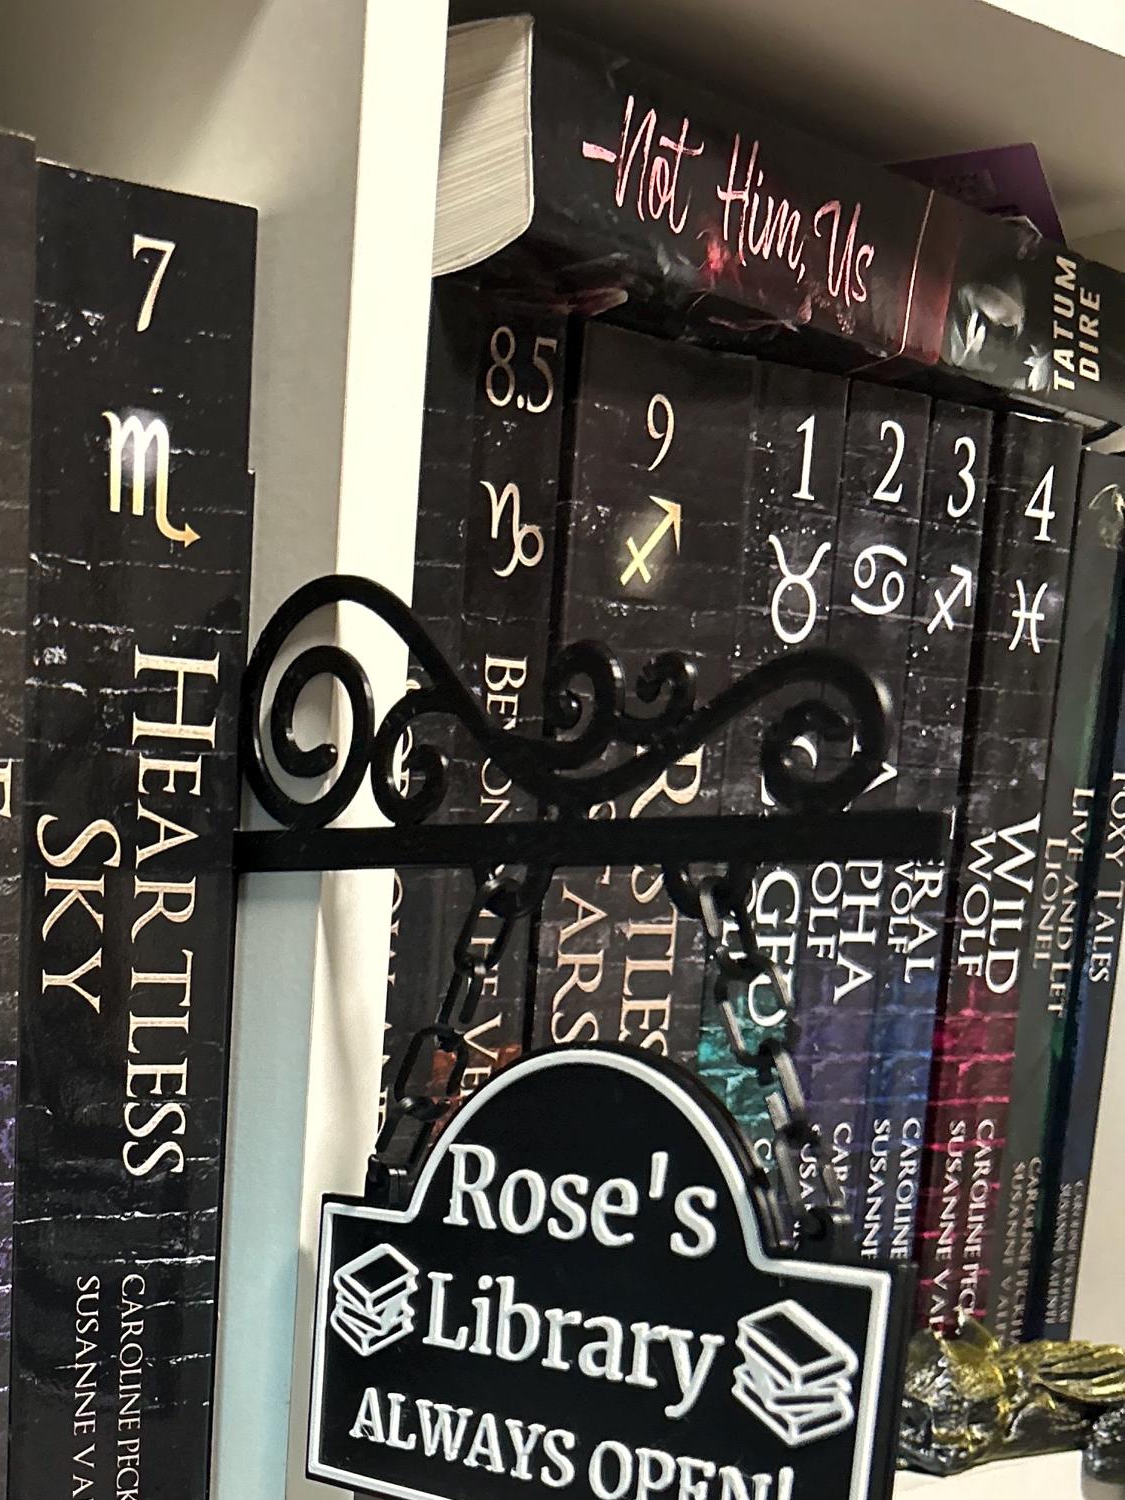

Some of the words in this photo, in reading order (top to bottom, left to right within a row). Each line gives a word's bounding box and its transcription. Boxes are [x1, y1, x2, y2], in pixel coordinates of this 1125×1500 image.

[716, 133, 807, 283] Him,
[813, 199, 875, 306] Us
[132, 235, 175, 332] 7
[1053, 256, 1076, 390] TATUM
[1079, 287, 1100, 382] DIRE
[485, 326, 558, 413] 8.5
[647, 394, 674, 471] 9
[792, 415, 816, 501] 1
[878, 420, 906, 503] 2
[948, 437, 977, 518] 3
[1025, 466, 1055, 542] 4
[1068, 787, 1095, 861] LIVE
[36, 814, 123, 1014] SKY
[122, 644, 220, 1178] HEARTLESS
[807, 862, 842, 959] OLF
[957, 832, 998, 978] WOLF
[984, 813, 1041, 994] WILD
[1032, 838, 1068, 968] LIONEL
[1058, 875, 1080, 950] AND
[1089, 880, 1125, 983] TALES
[1048, 961, 1072, 1019] LET
[442, 1143, 718, 1258] Rose's
[860, 1118, 892, 1260] SUSANNE
[889, 1116, 922, 1260] CAROLINE
[935, 1119, 967, 1262] SUSANNE
[963, 1118, 996, 1260] CAROLINE
[72, 1275, 101, 1435] SUSANNE
[119, 1272, 148, 1432] CAROLINE
[422, 1271, 725, 1418] Library
[348, 1386, 577, 1488] ALWAYS
